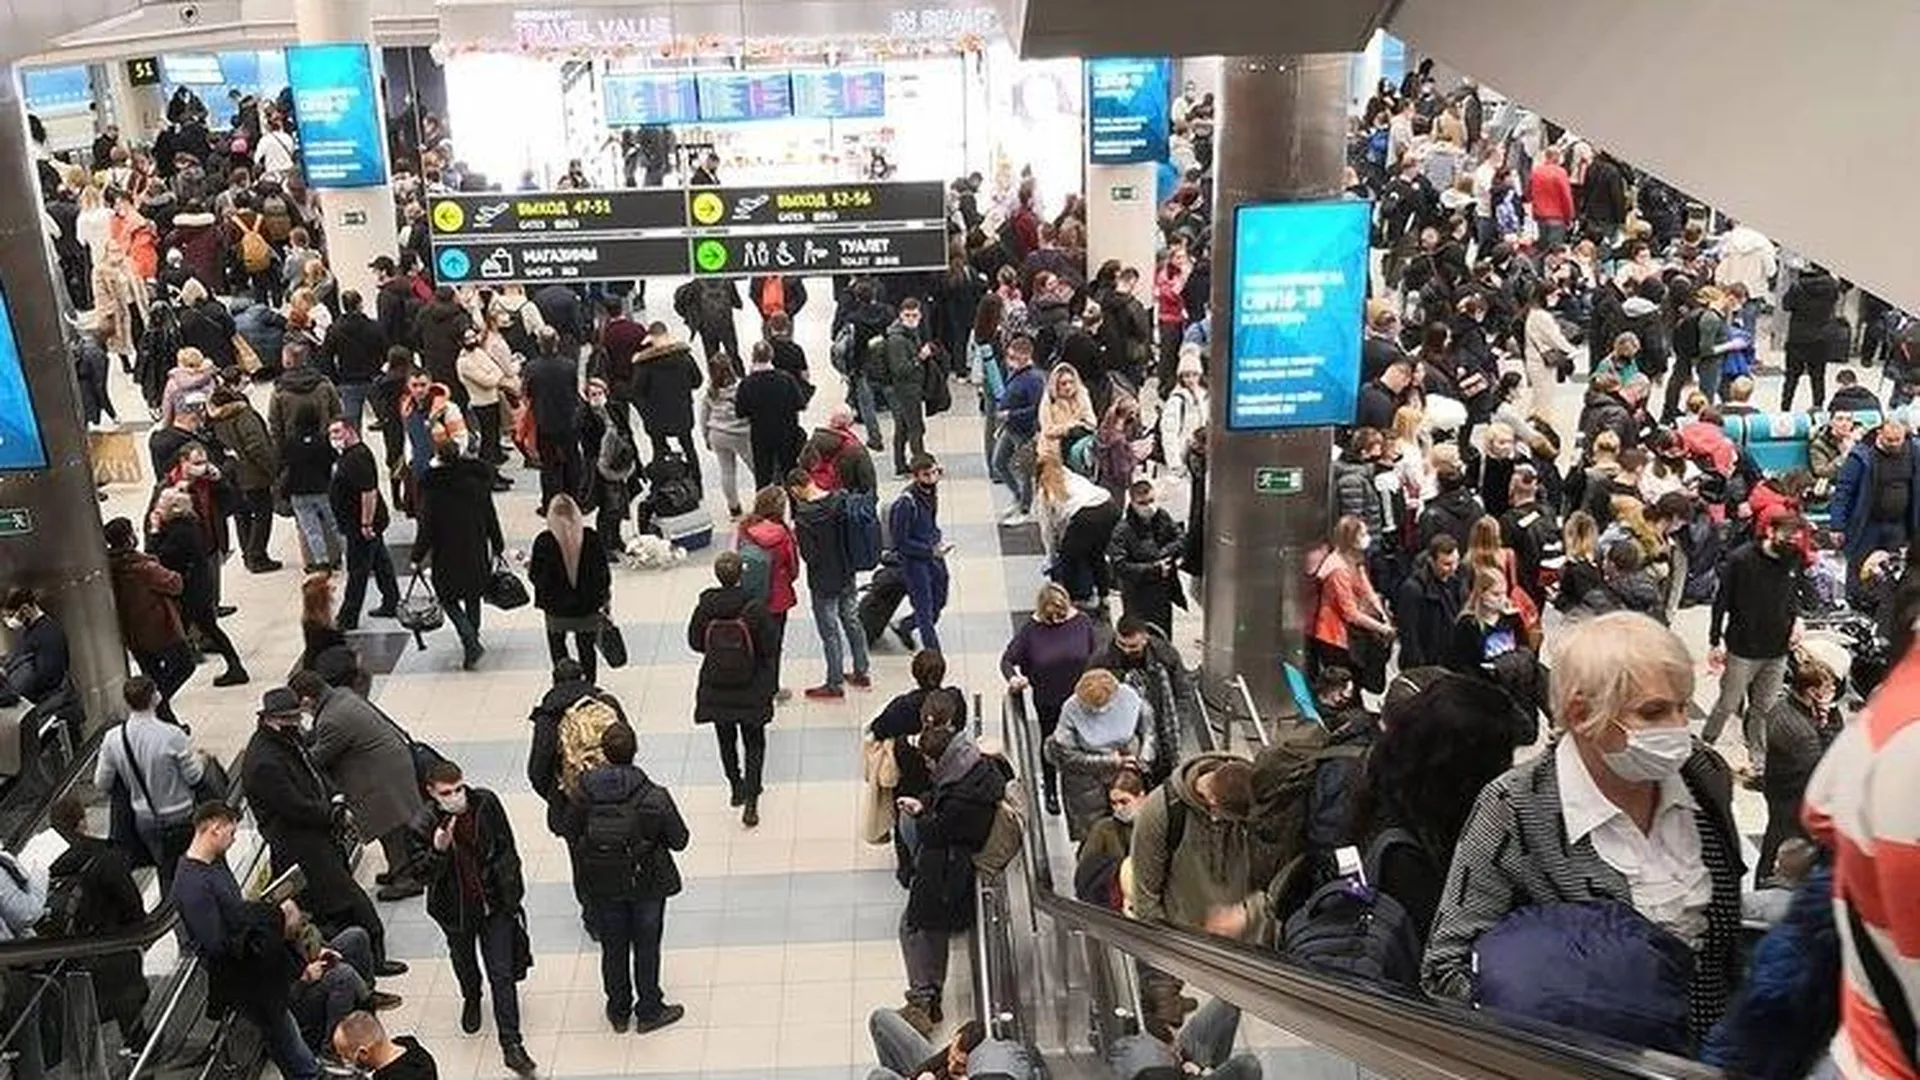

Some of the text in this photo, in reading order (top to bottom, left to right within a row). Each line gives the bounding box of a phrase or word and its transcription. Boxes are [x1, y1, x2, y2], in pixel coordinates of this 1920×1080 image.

[135, 61, 154, 78] 51
[517, 199, 612, 216] ВЫХОД 47-51
[776, 190, 872, 208] ВЫХОД 52-56
[838, 238, 890, 254] ТУАЛЕТ
